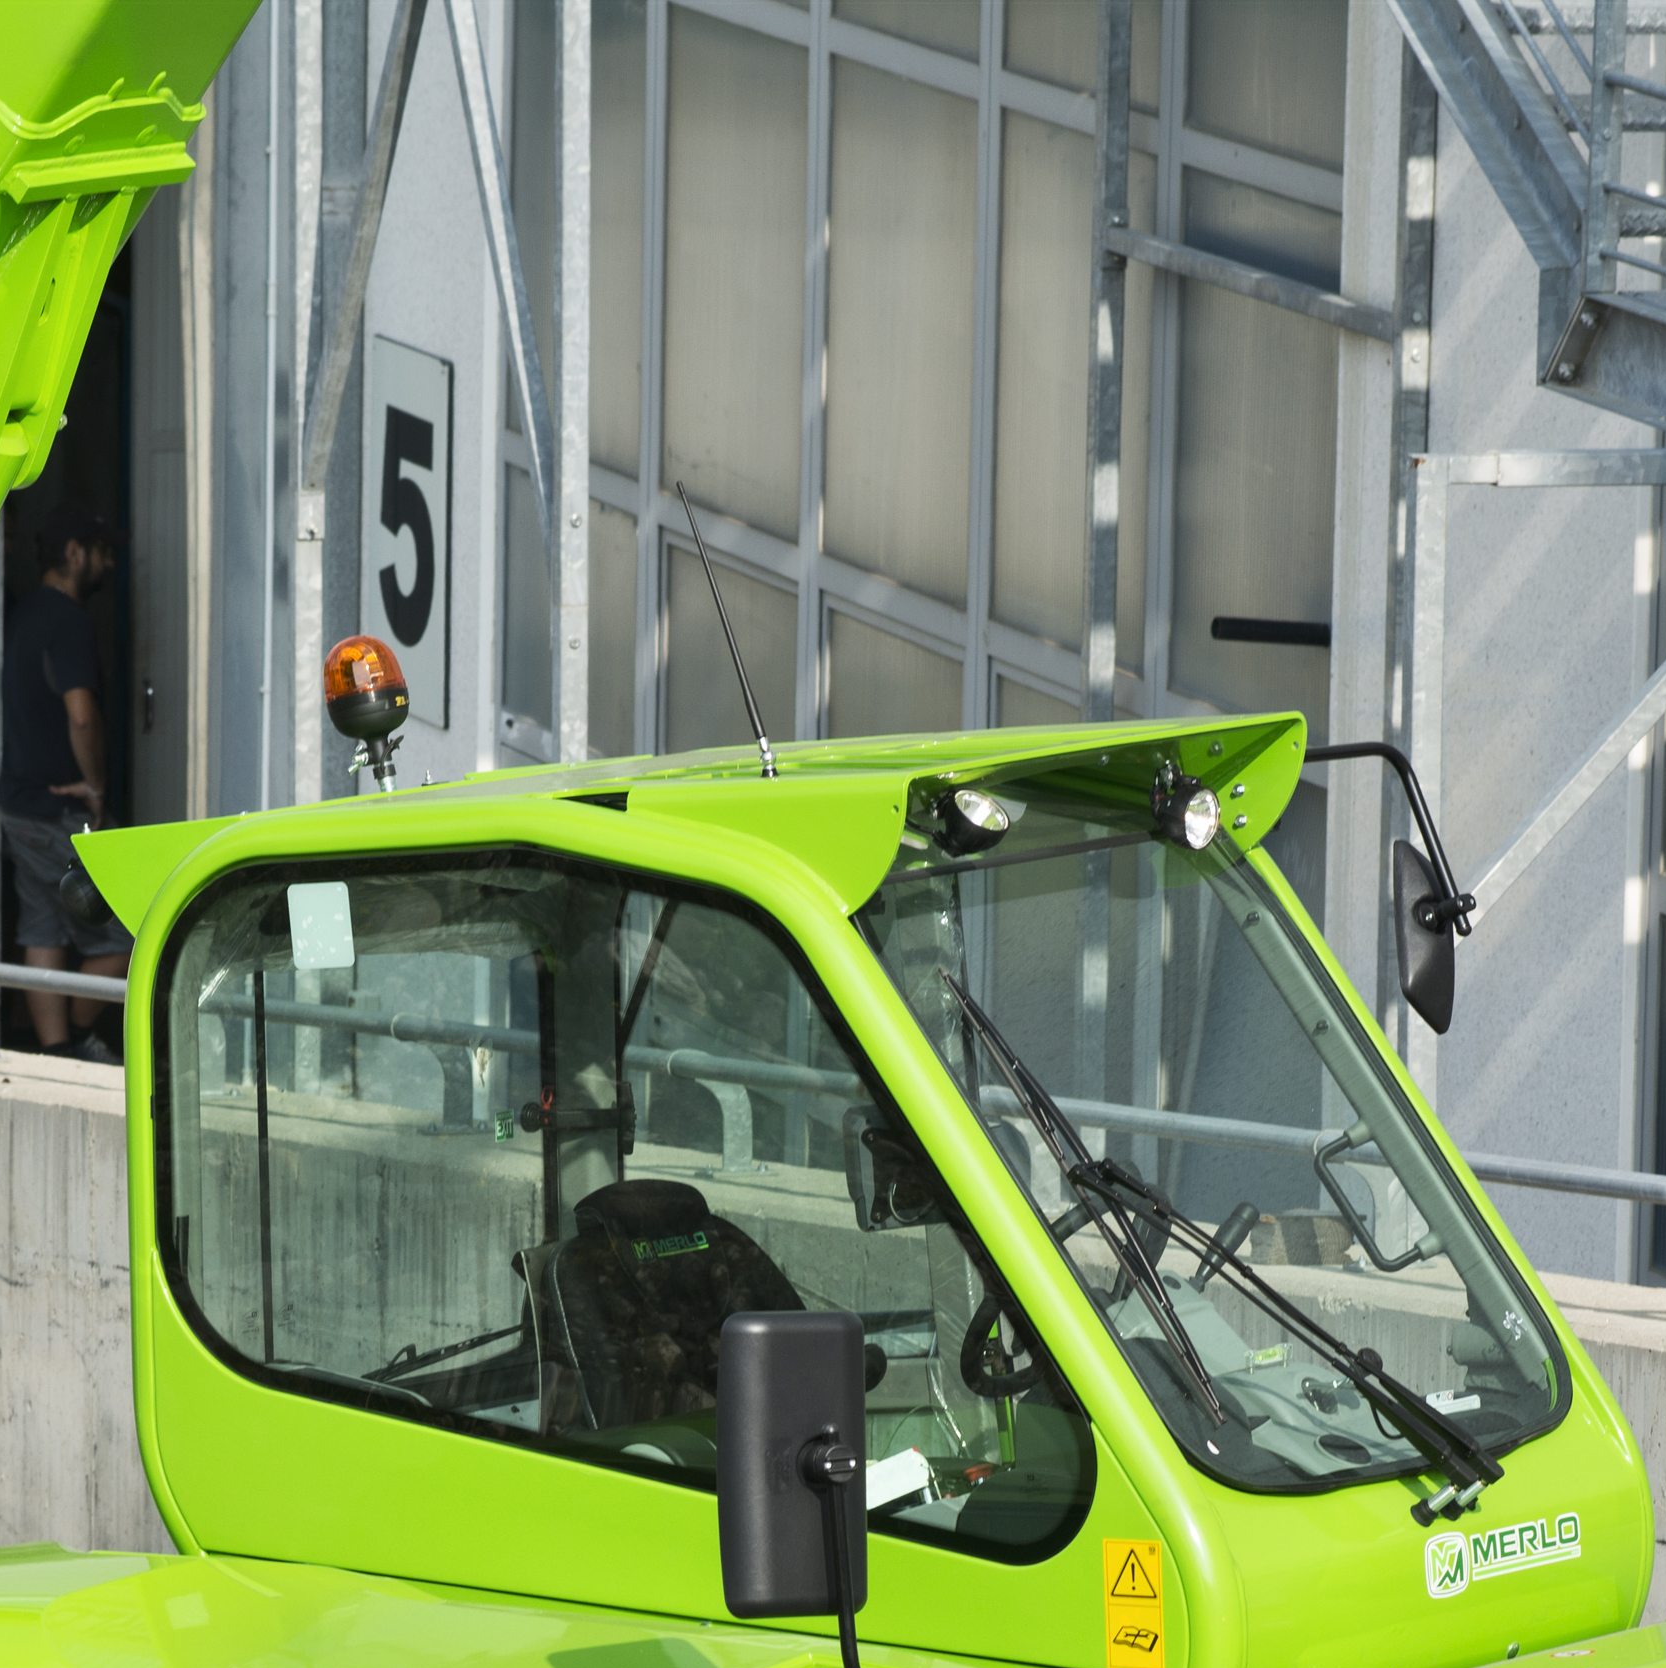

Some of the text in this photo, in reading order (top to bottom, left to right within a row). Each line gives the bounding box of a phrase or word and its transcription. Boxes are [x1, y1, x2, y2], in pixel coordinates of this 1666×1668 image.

[379, 403, 435, 647] 5
[652, 1231, 707, 1254] MERLO
[1470, 1512, 1581, 1567] MERLO
